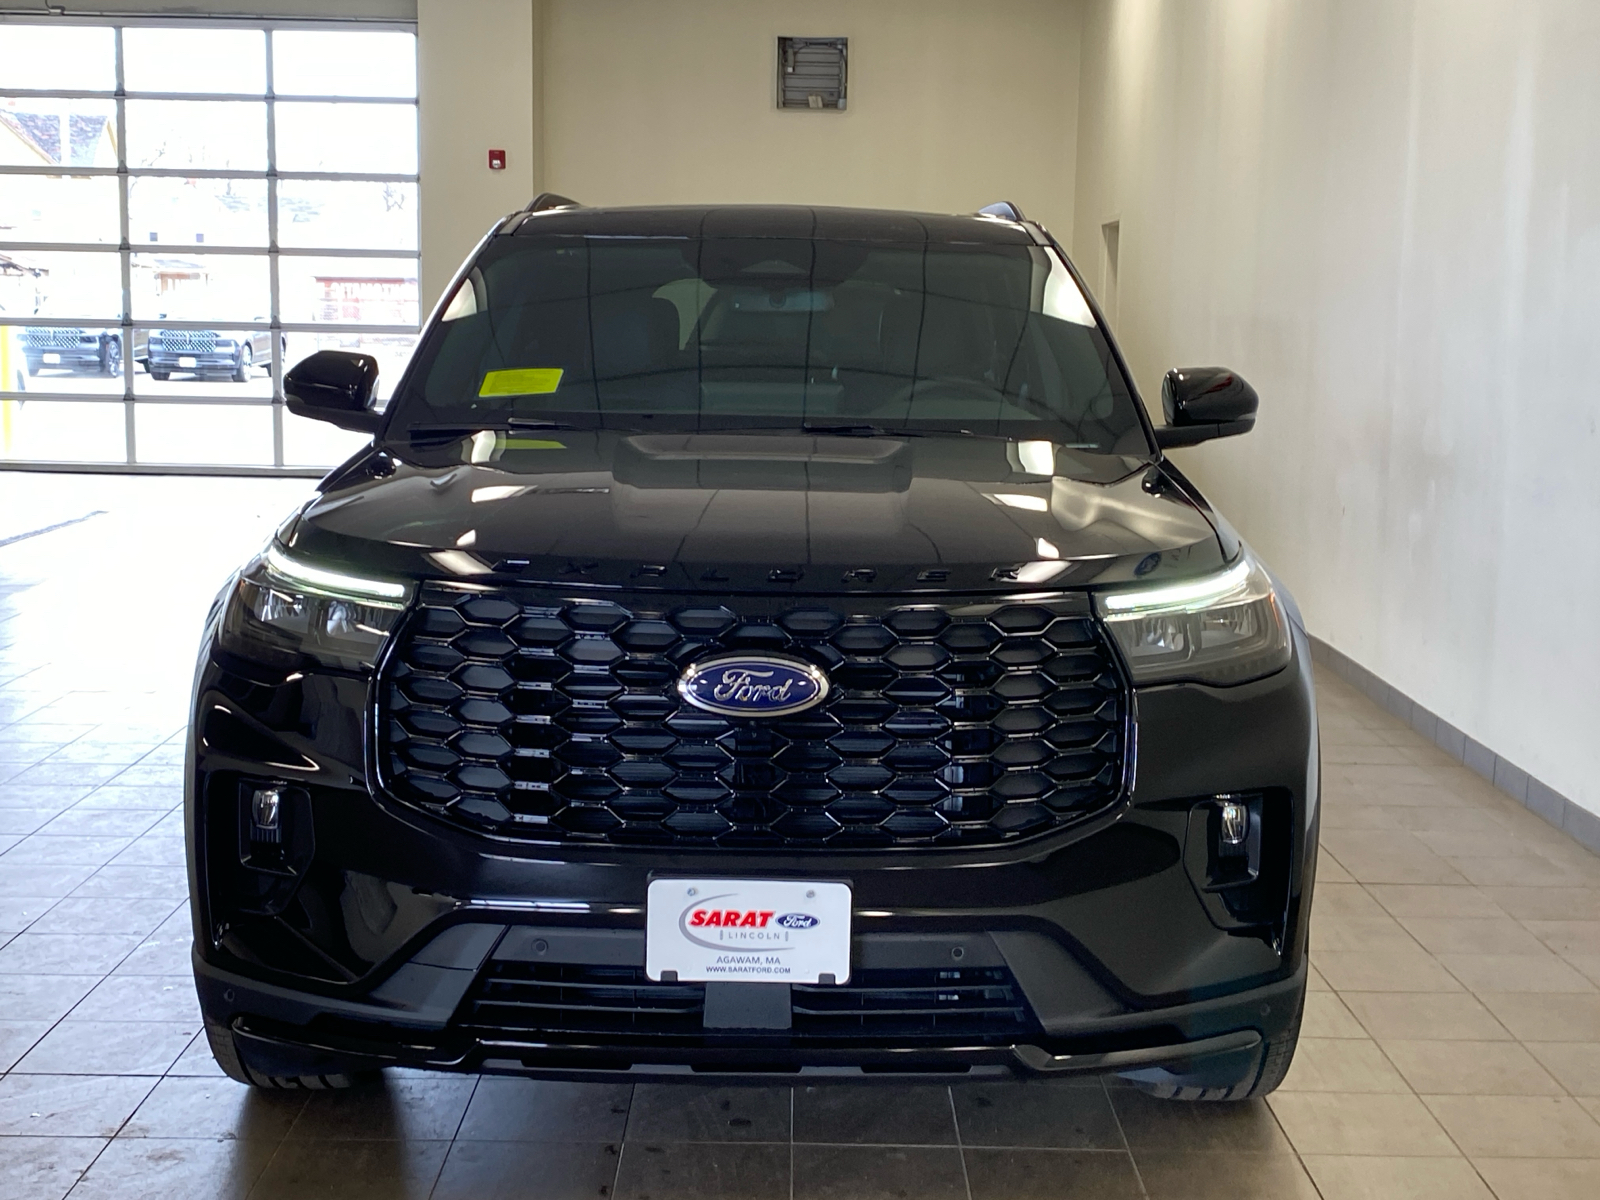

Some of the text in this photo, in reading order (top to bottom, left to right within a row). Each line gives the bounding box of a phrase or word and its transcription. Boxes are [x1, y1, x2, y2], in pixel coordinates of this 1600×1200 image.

[713, 668, 793, 701] Ford
[689, 908, 812, 929] SARAT Ford
[728, 931, 780, 940] LINCOLN
[716, 955, 781, 966] AGAWAM, MA
[706, 965, 791, 974] WWW.SARATFORD.COM
